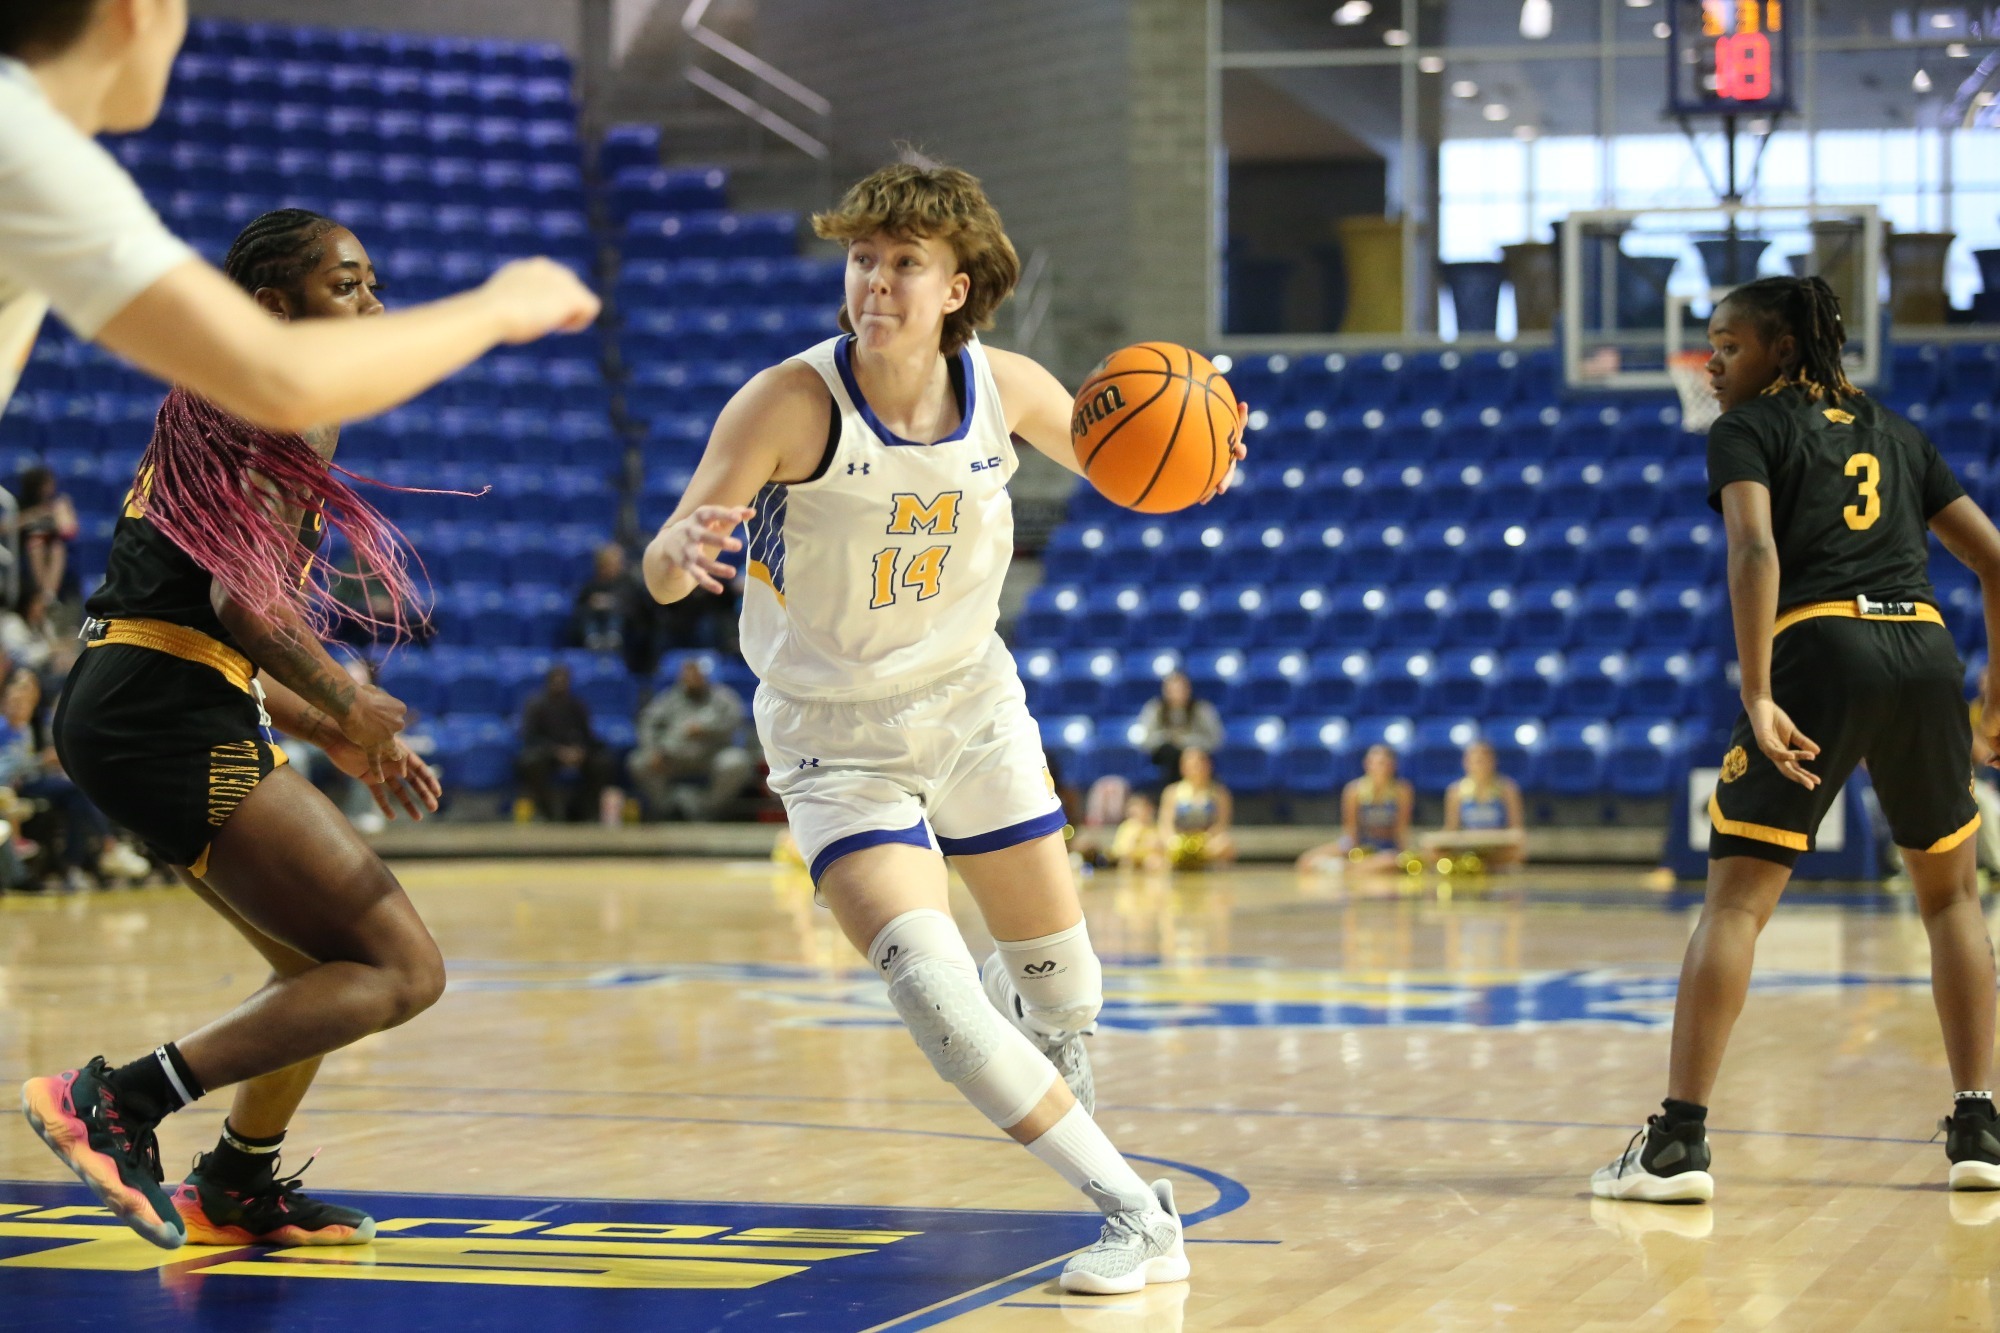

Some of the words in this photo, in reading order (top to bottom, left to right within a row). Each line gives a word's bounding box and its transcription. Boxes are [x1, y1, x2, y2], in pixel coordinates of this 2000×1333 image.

[970, 456, 1000, 473] SLC
[1843, 452, 1881, 531] 3
[886, 490, 963, 535] M
[869, 545, 952, 610] 14
